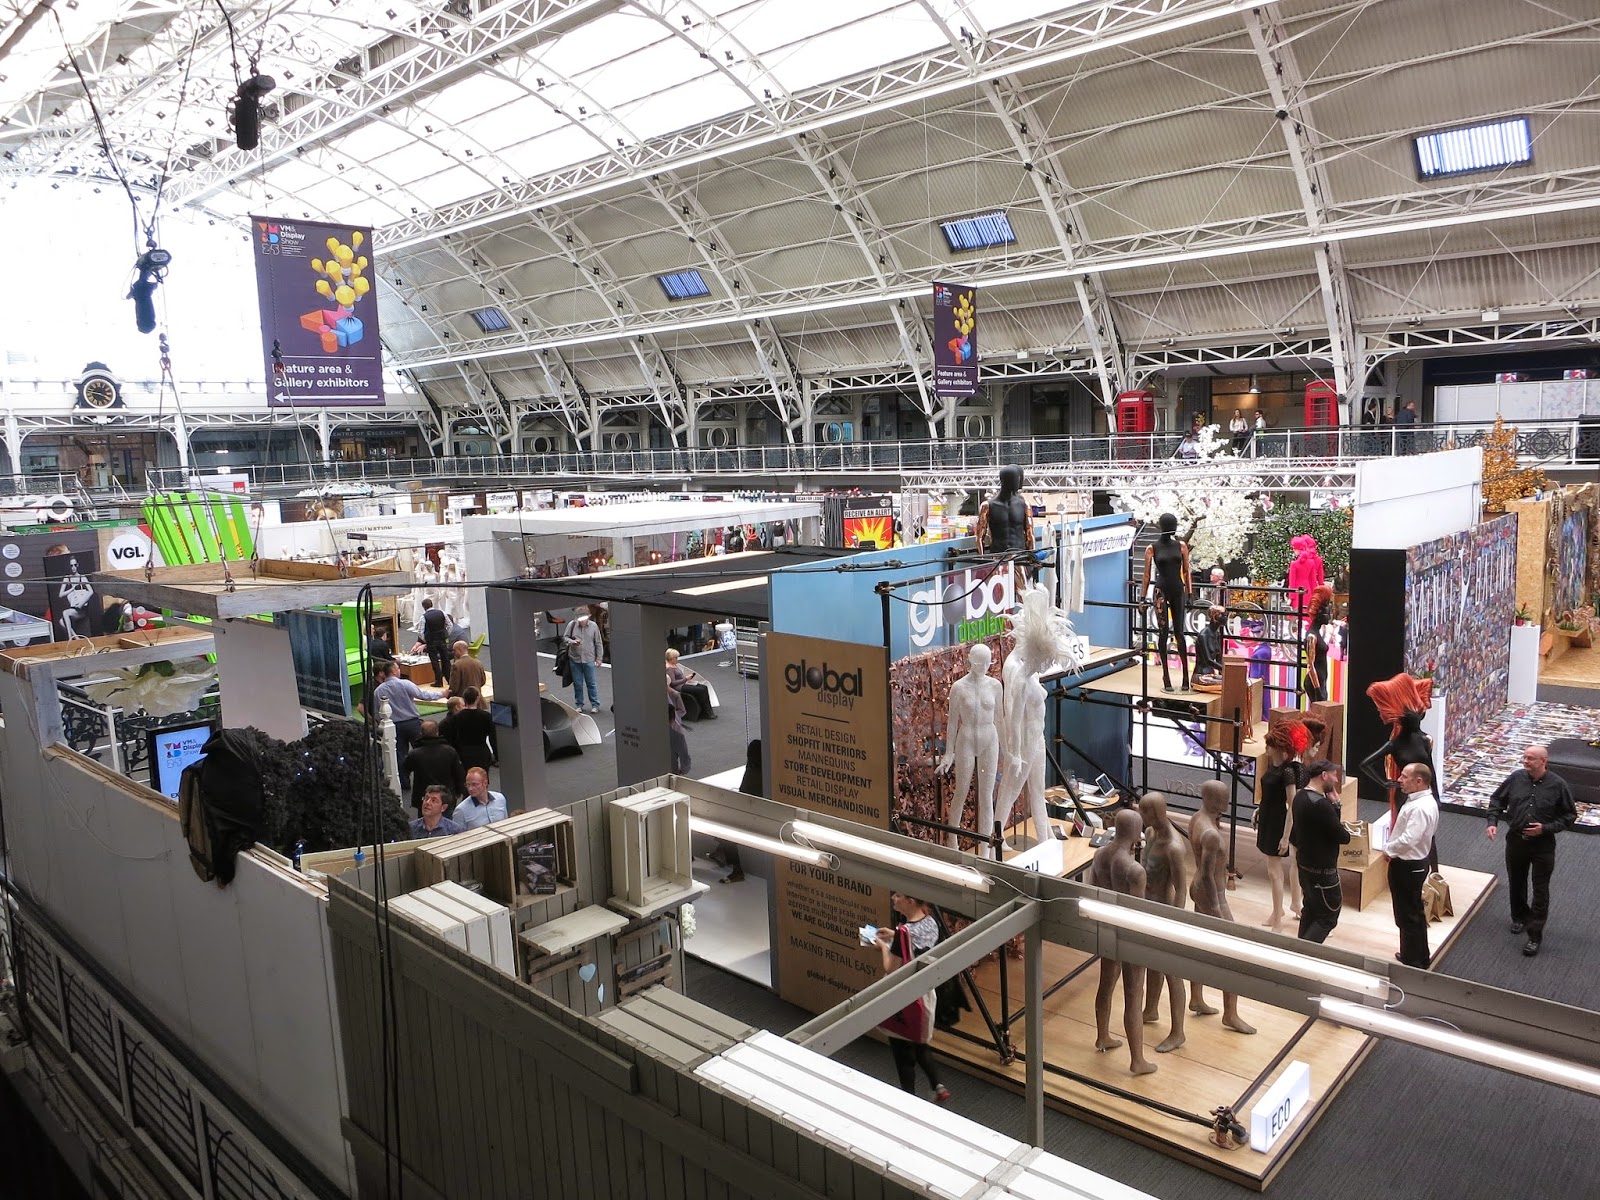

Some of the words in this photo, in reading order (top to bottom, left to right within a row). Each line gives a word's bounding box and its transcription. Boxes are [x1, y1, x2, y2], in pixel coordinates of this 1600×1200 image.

[280, 232, 305, 240] Display
[345, 365, 353, 374] &
[274, 378, 313, 389] Gallery
[316, 377, 369, 387] exhibitors
[875, 508, 890, 516] ALERT
[1083, 533, 1130, 554] MANNEQUINS
[910, 561, 1015, 647] global
[958, 612, 1005, 643] display
[784, 659, 863, 697] global
[817, 690, 854, 711] display
[796, 723, 823, 739] RETAIL
[825, 727, 856, 744] DESIGN
[787, 735, 820, 752] SHOPFIT
[822, 740, 867, 760] INTERIORS
[798, 750, 856, 771] MANNEQUINS
[784, 759, 809, 775] STORE
[811, 764, 872, 789] DEVELOPMENT
[796, 776, 823, 791] RETAIL
[825, 781, 859, 800] DISPLAY
[778, 784, 807, 800] VISUAL
[808, 791, 880, 819] MERCHANDISING
[789, 862, 807, 876] FOR
[809, 865, 835, 885] YOUR
[837, 876, 872, 897] BRAND
[787, 881, 810, 893] whether
[825, 893, 859, 909] spectacular
[860, 904, 877, 915] retail
[787, 890, 807, 901] interior
[808, 897, 815, 905] or
[821, 901, 838, 913] large
[839, 907, 856, 919] scale
[787, 900, 810, 912] across
[811, 907, 838, 922] multiple
[791, 909, 803, 920] WE
[803, 914, 816, 925] ARE
[817, 919, 844, 935] GLOBAL
[790, 935, 823, 957] MAKING
[825, 949, 853, 968] RETAIL
[854, 960, 877, 976] EASY
[1271, 1097, 1291, 1138] ECO
